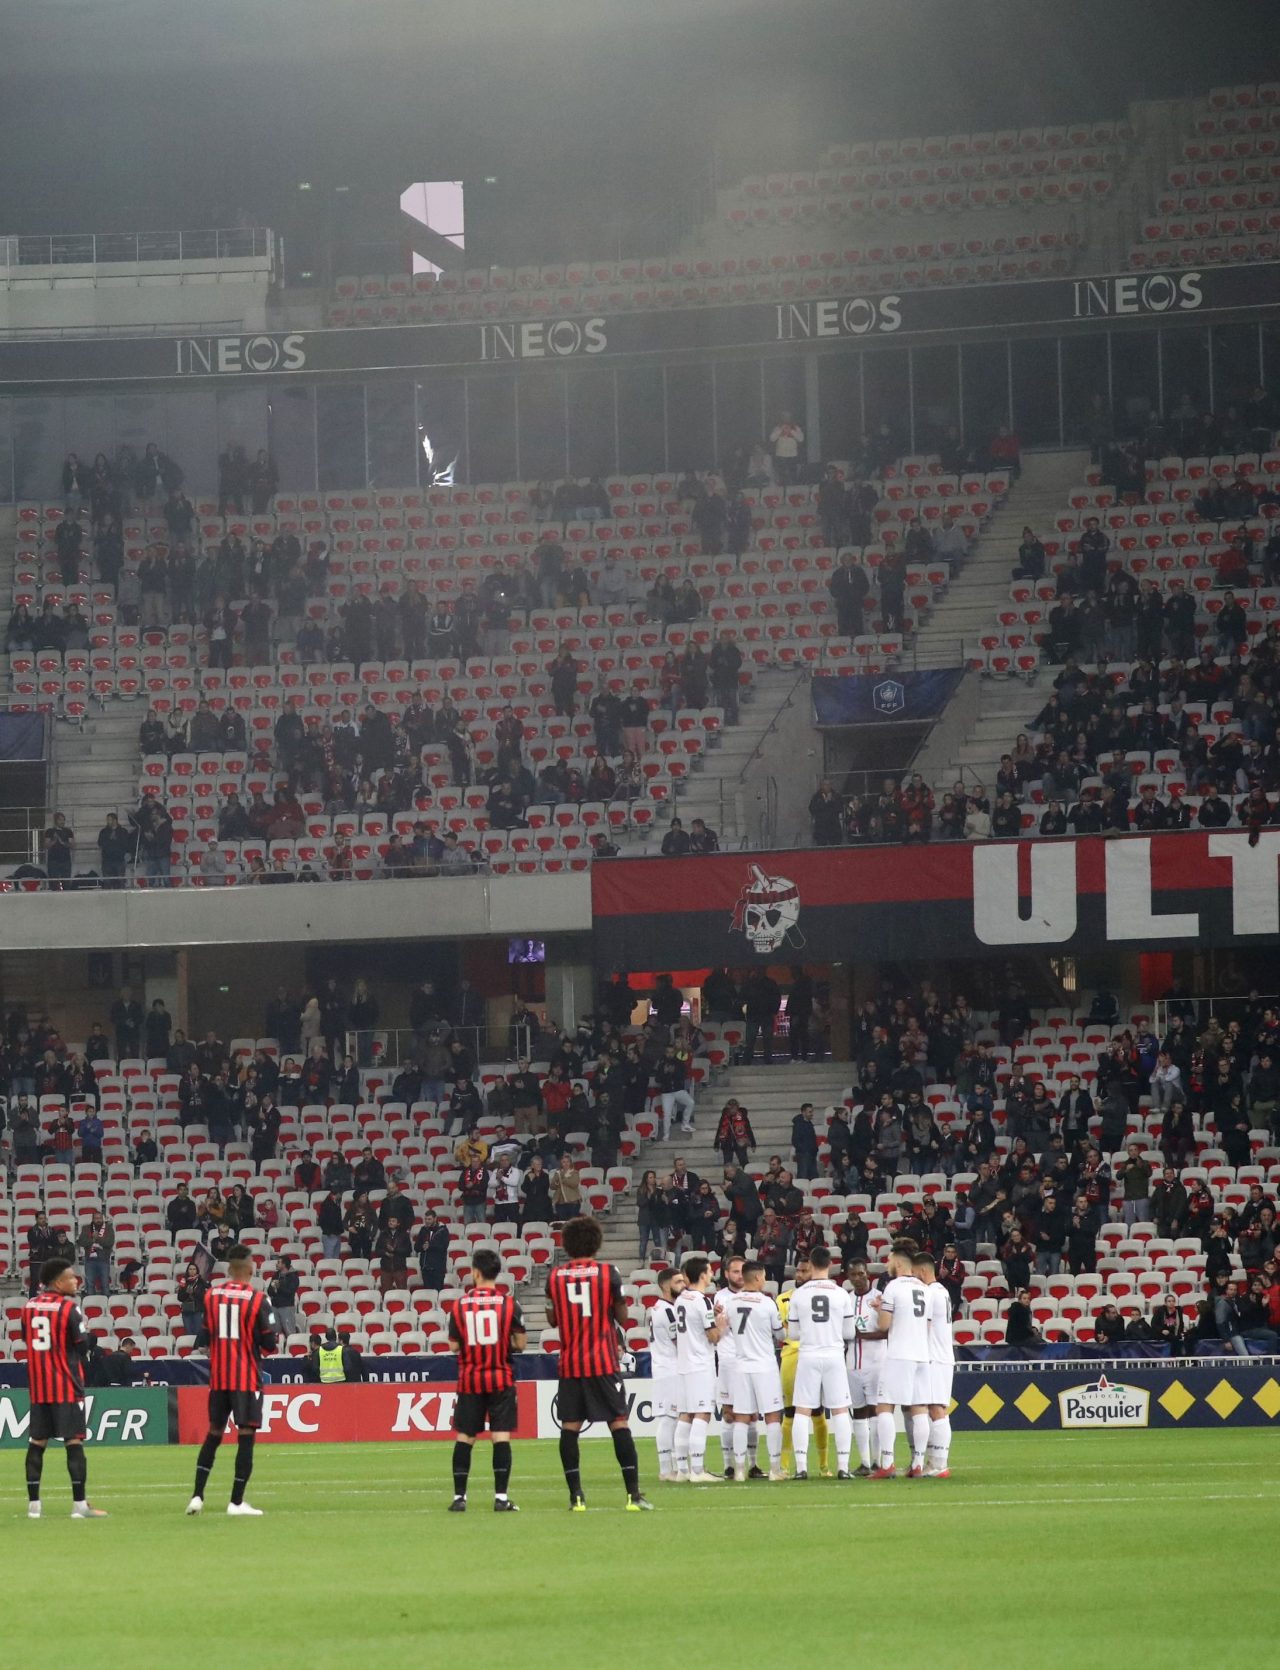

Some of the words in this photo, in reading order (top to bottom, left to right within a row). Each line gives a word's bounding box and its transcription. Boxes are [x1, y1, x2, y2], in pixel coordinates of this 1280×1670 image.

[1073, 272, 1203, 317] INEOS
[775, 296, 902, 340] INEOS
[175, 335, 306, 374] INEOS
[479, 318, 608, 360] INEOS
[567, 1282, 593, 1317] 4
[811, 1295, 830, 1323] 9
[912, 1289, 926, 1318] 5
[31, 1316, 51, 1351] 3
[219, 1303, 240, 1339] 11
[465, 1310, 499, 1345] 10
[737, 1307, 753, 1335] 7
[224, 1393, 322, 1433] FC
[1067, 1398, 1143, 1423] Pasquier
[1081, 1393, 1127, 1401] brioche
